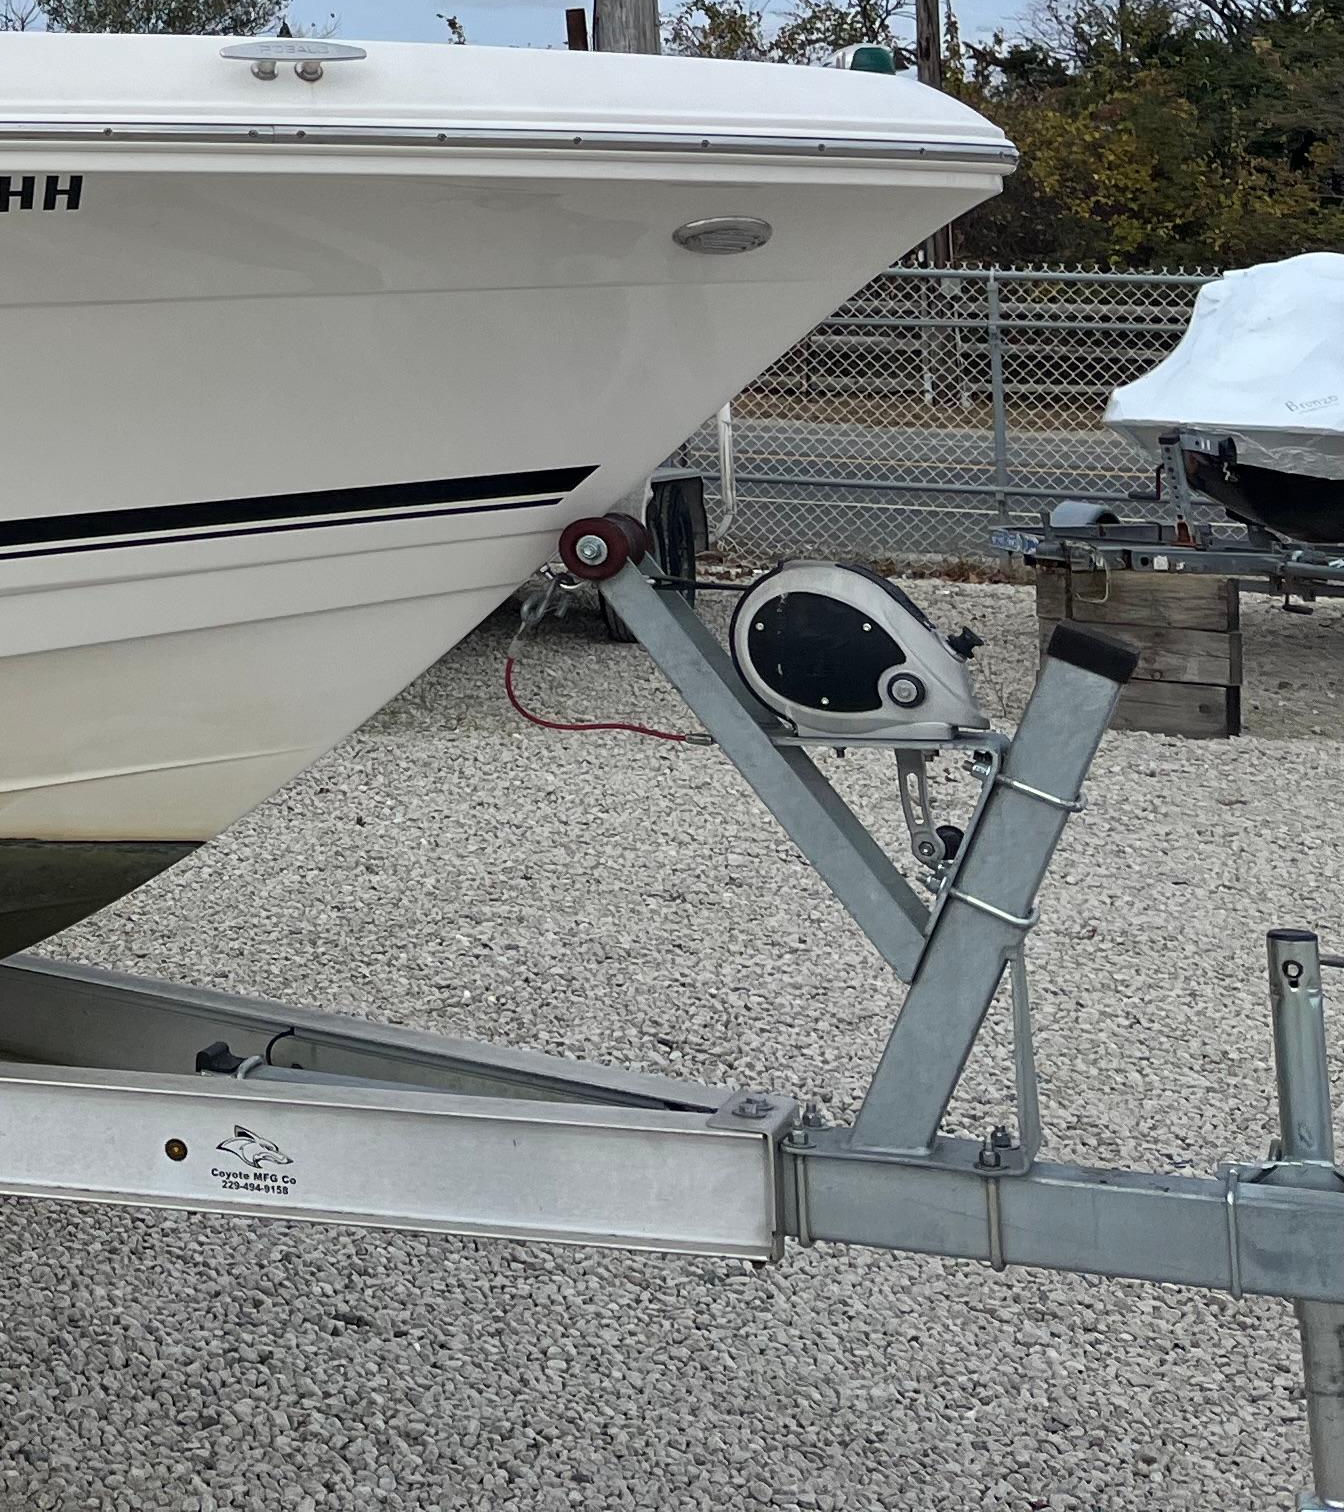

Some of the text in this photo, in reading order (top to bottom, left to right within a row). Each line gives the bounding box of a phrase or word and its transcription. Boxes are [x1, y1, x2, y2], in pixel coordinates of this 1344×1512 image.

[211, 1168, 297, 1185] Coyote MFG Co
